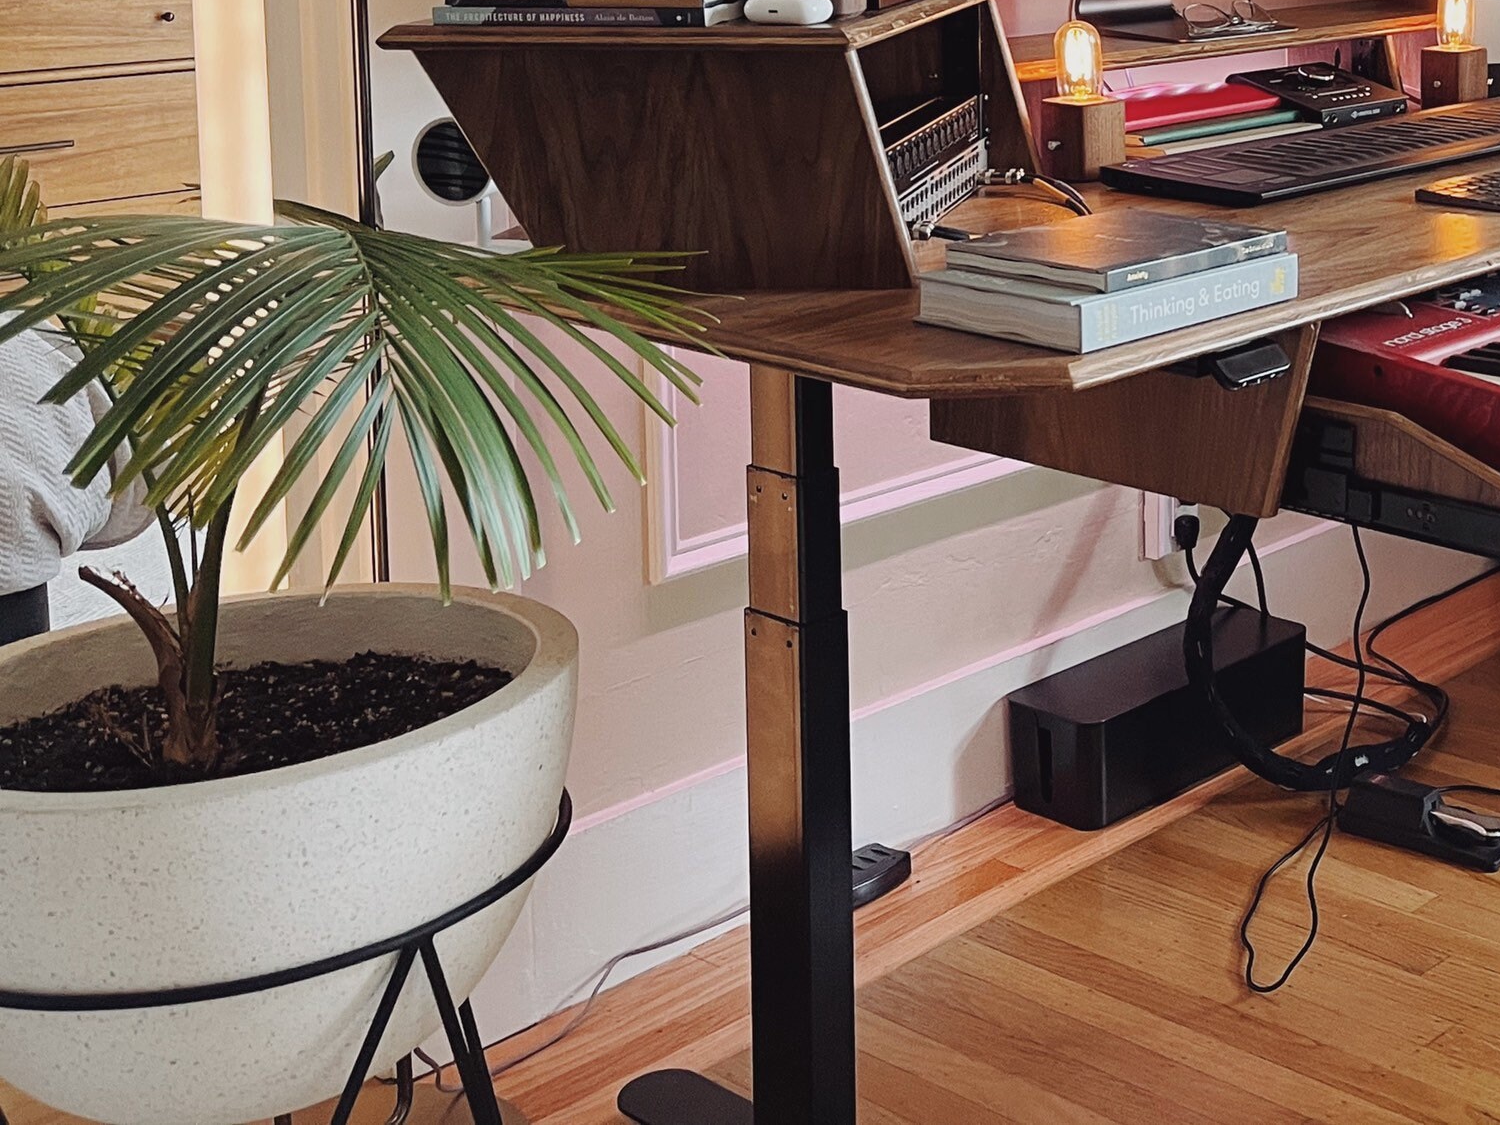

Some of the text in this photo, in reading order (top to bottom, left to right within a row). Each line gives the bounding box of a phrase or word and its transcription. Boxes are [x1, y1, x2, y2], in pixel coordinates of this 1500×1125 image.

[446, 12, 654, 22] THE ARCHITECTURE OF HAPPINESS Alain de Botton
[1130, 297, 1196, 325] Thinking
[1198, 288, 1210, 307] &
[1213, 279, 1261, 302] Eating
[1382, 331, 1424, 347] nord
[1419, 321, 1462, 335] stage
